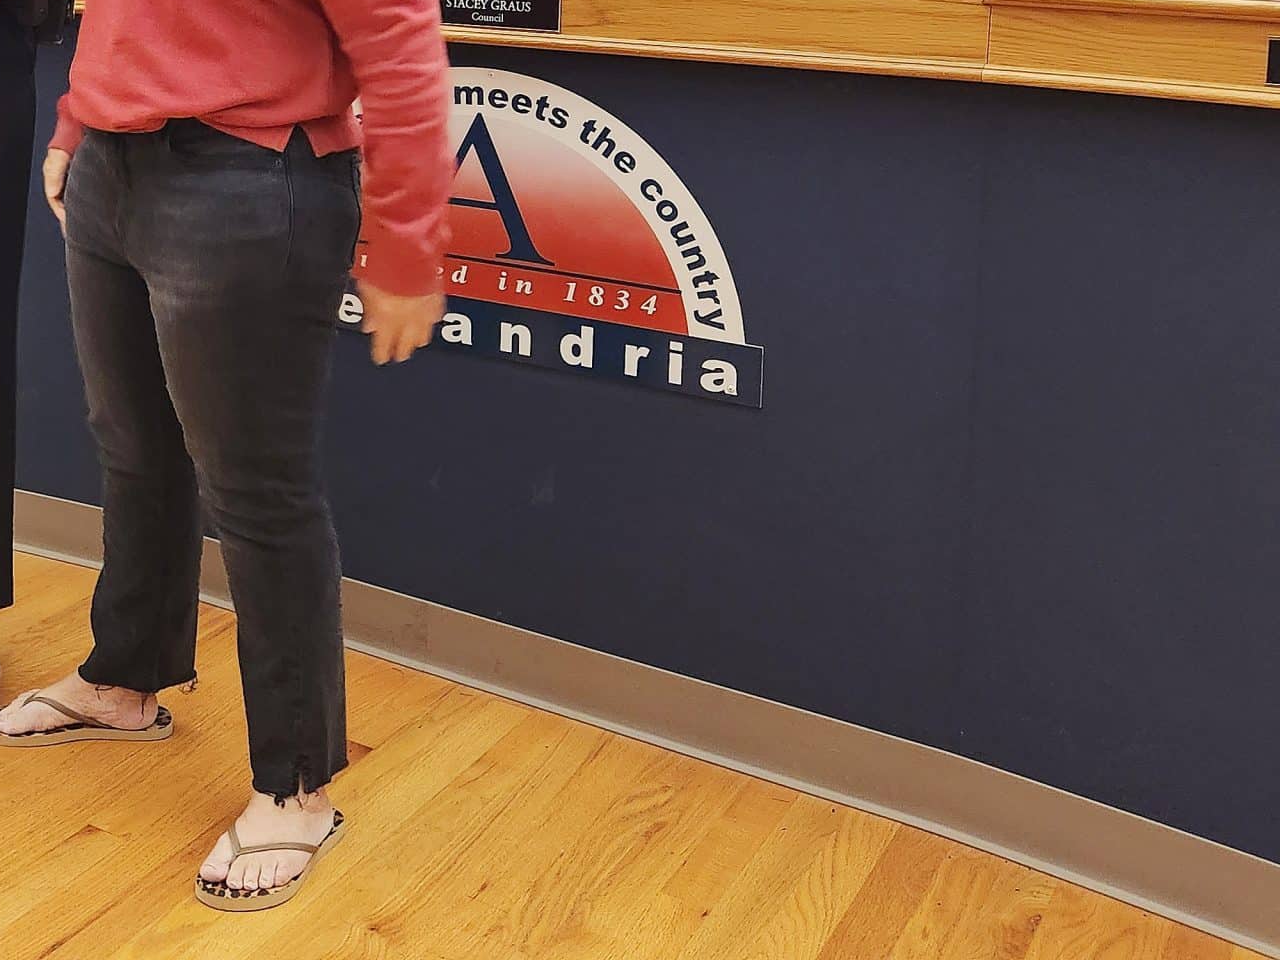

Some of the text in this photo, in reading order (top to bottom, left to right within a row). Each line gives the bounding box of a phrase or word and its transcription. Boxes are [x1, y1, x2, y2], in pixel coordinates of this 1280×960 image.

[471, 12, 504, 22] Council
[490, 0, 531, 12] GRAUS
[448, 112, 556, 266] A
[454, 85, 726, 331] meets the country
[498, 271, 657, 315] in 1834
[339, 293, 738, 396] eandria
